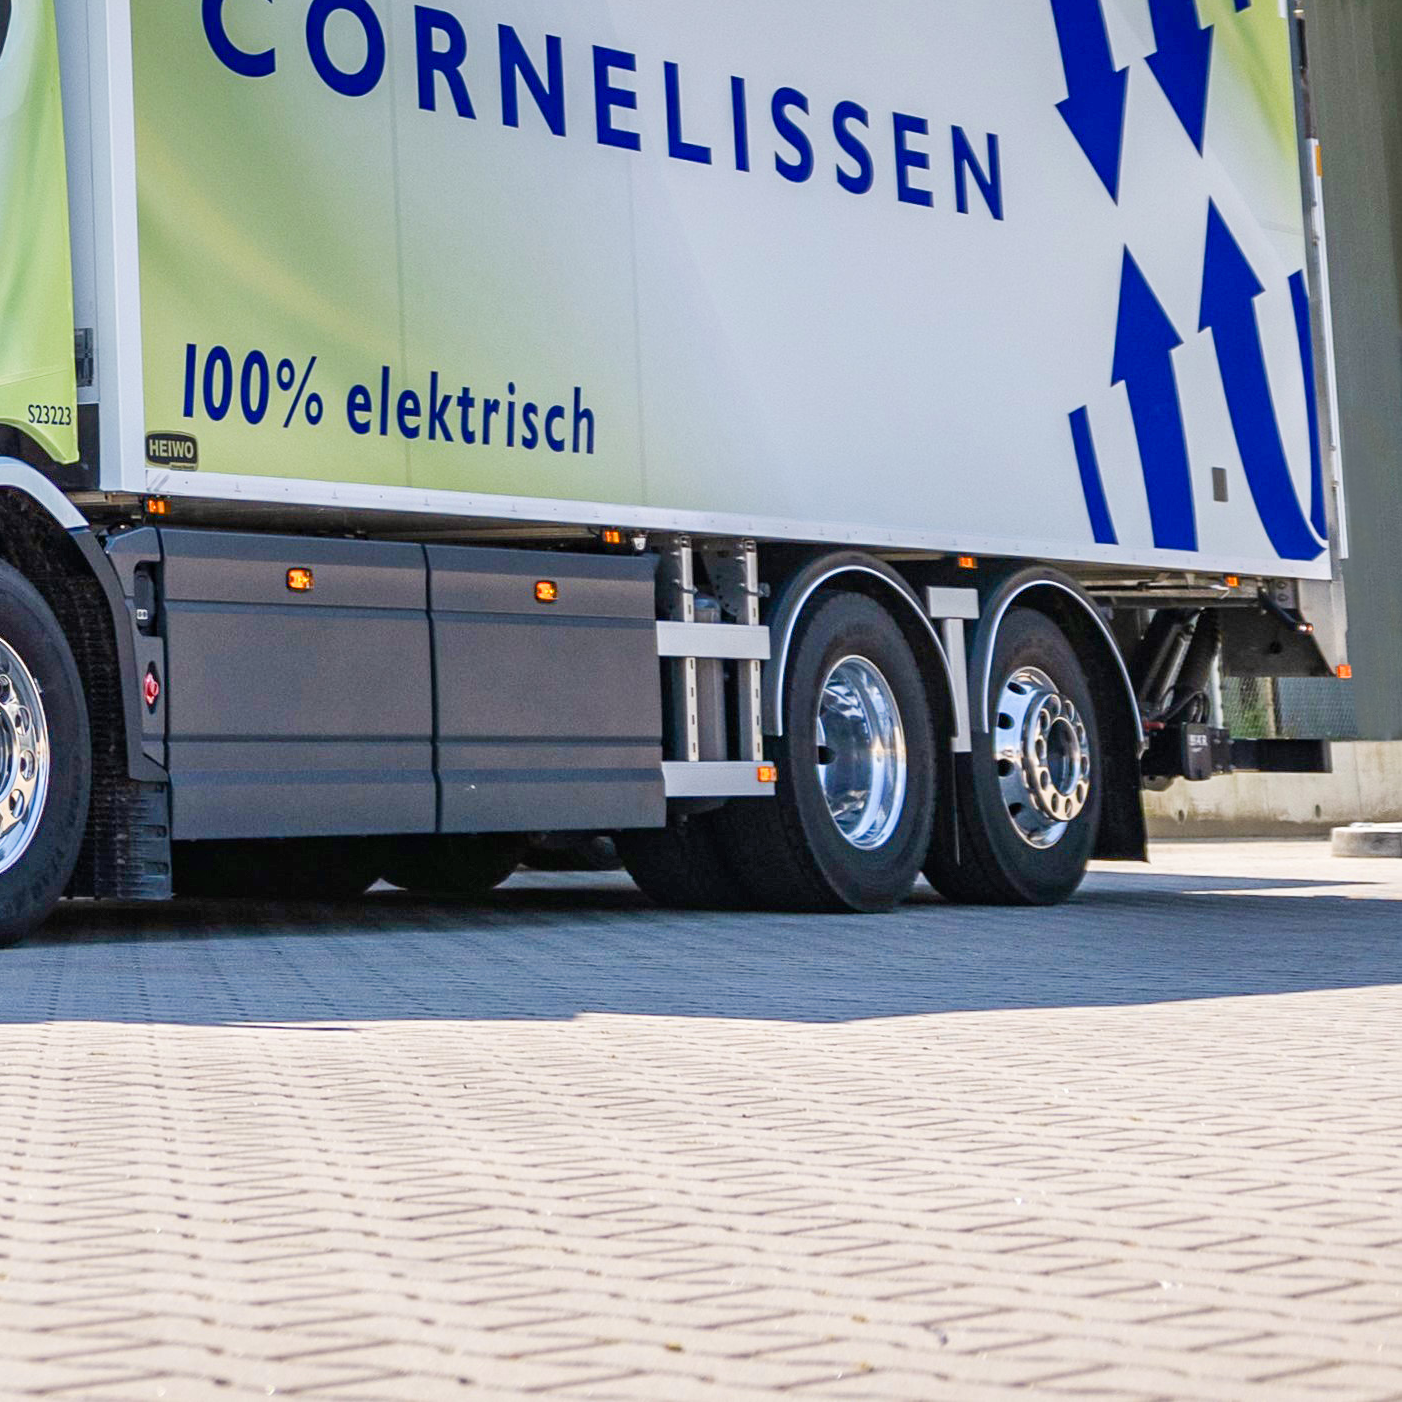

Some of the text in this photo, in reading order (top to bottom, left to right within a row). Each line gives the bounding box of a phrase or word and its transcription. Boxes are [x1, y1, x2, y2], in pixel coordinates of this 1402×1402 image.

[183, 343, 595, 455] 100% elektrisch
[27, 404, 72, 427] S23223
[149, 439, 195, 458] HEIWO
